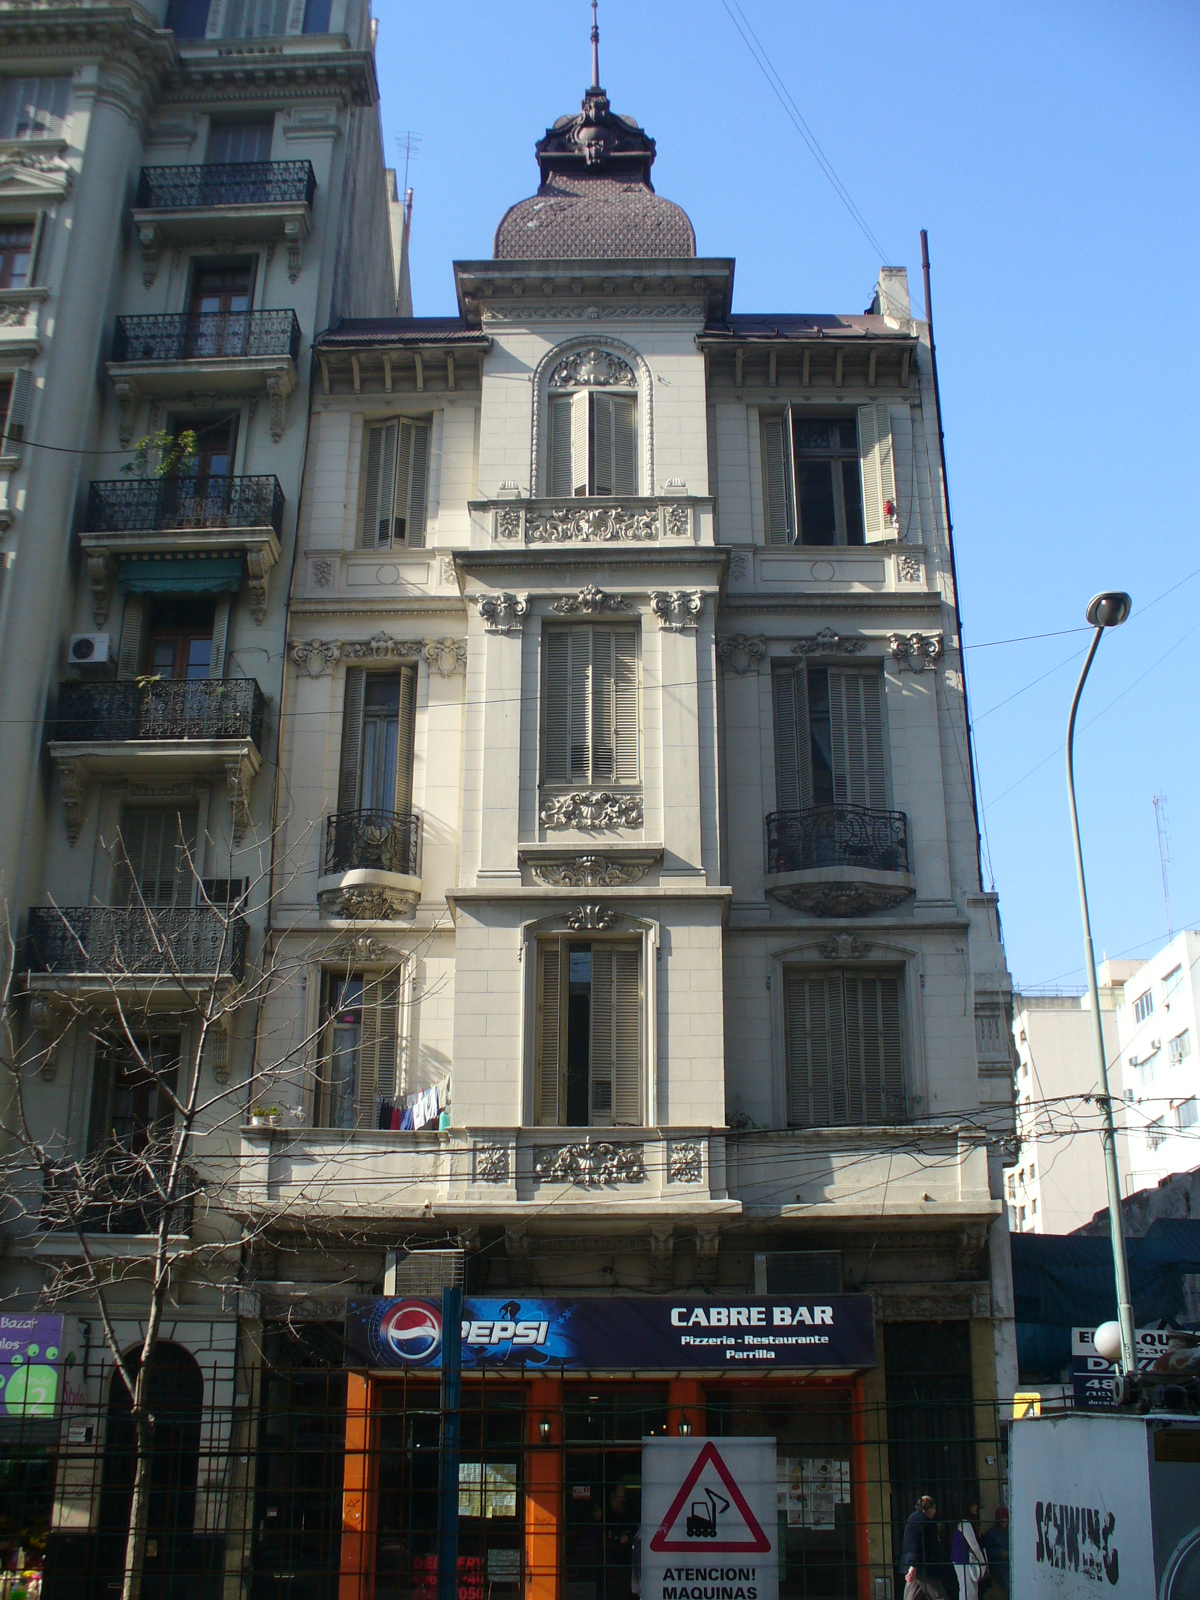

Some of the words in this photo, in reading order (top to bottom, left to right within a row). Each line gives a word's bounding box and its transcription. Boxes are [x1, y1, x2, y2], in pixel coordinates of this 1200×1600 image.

[1, 1316, 38, 1329] Bazar
[670, 1307, 767, 1326] CABRE
[772, 1306, 834, 1326] BAR
[681, 1336, 735, 1345] Pizzeria
[744, 1335, 829, 1344] Restaurante
[726, 1350, 776, 1359] Parrilla
[663, 1568, 755, 1581] ATENCION!
[663, 1587, 757, 1600] MAQUINAS
